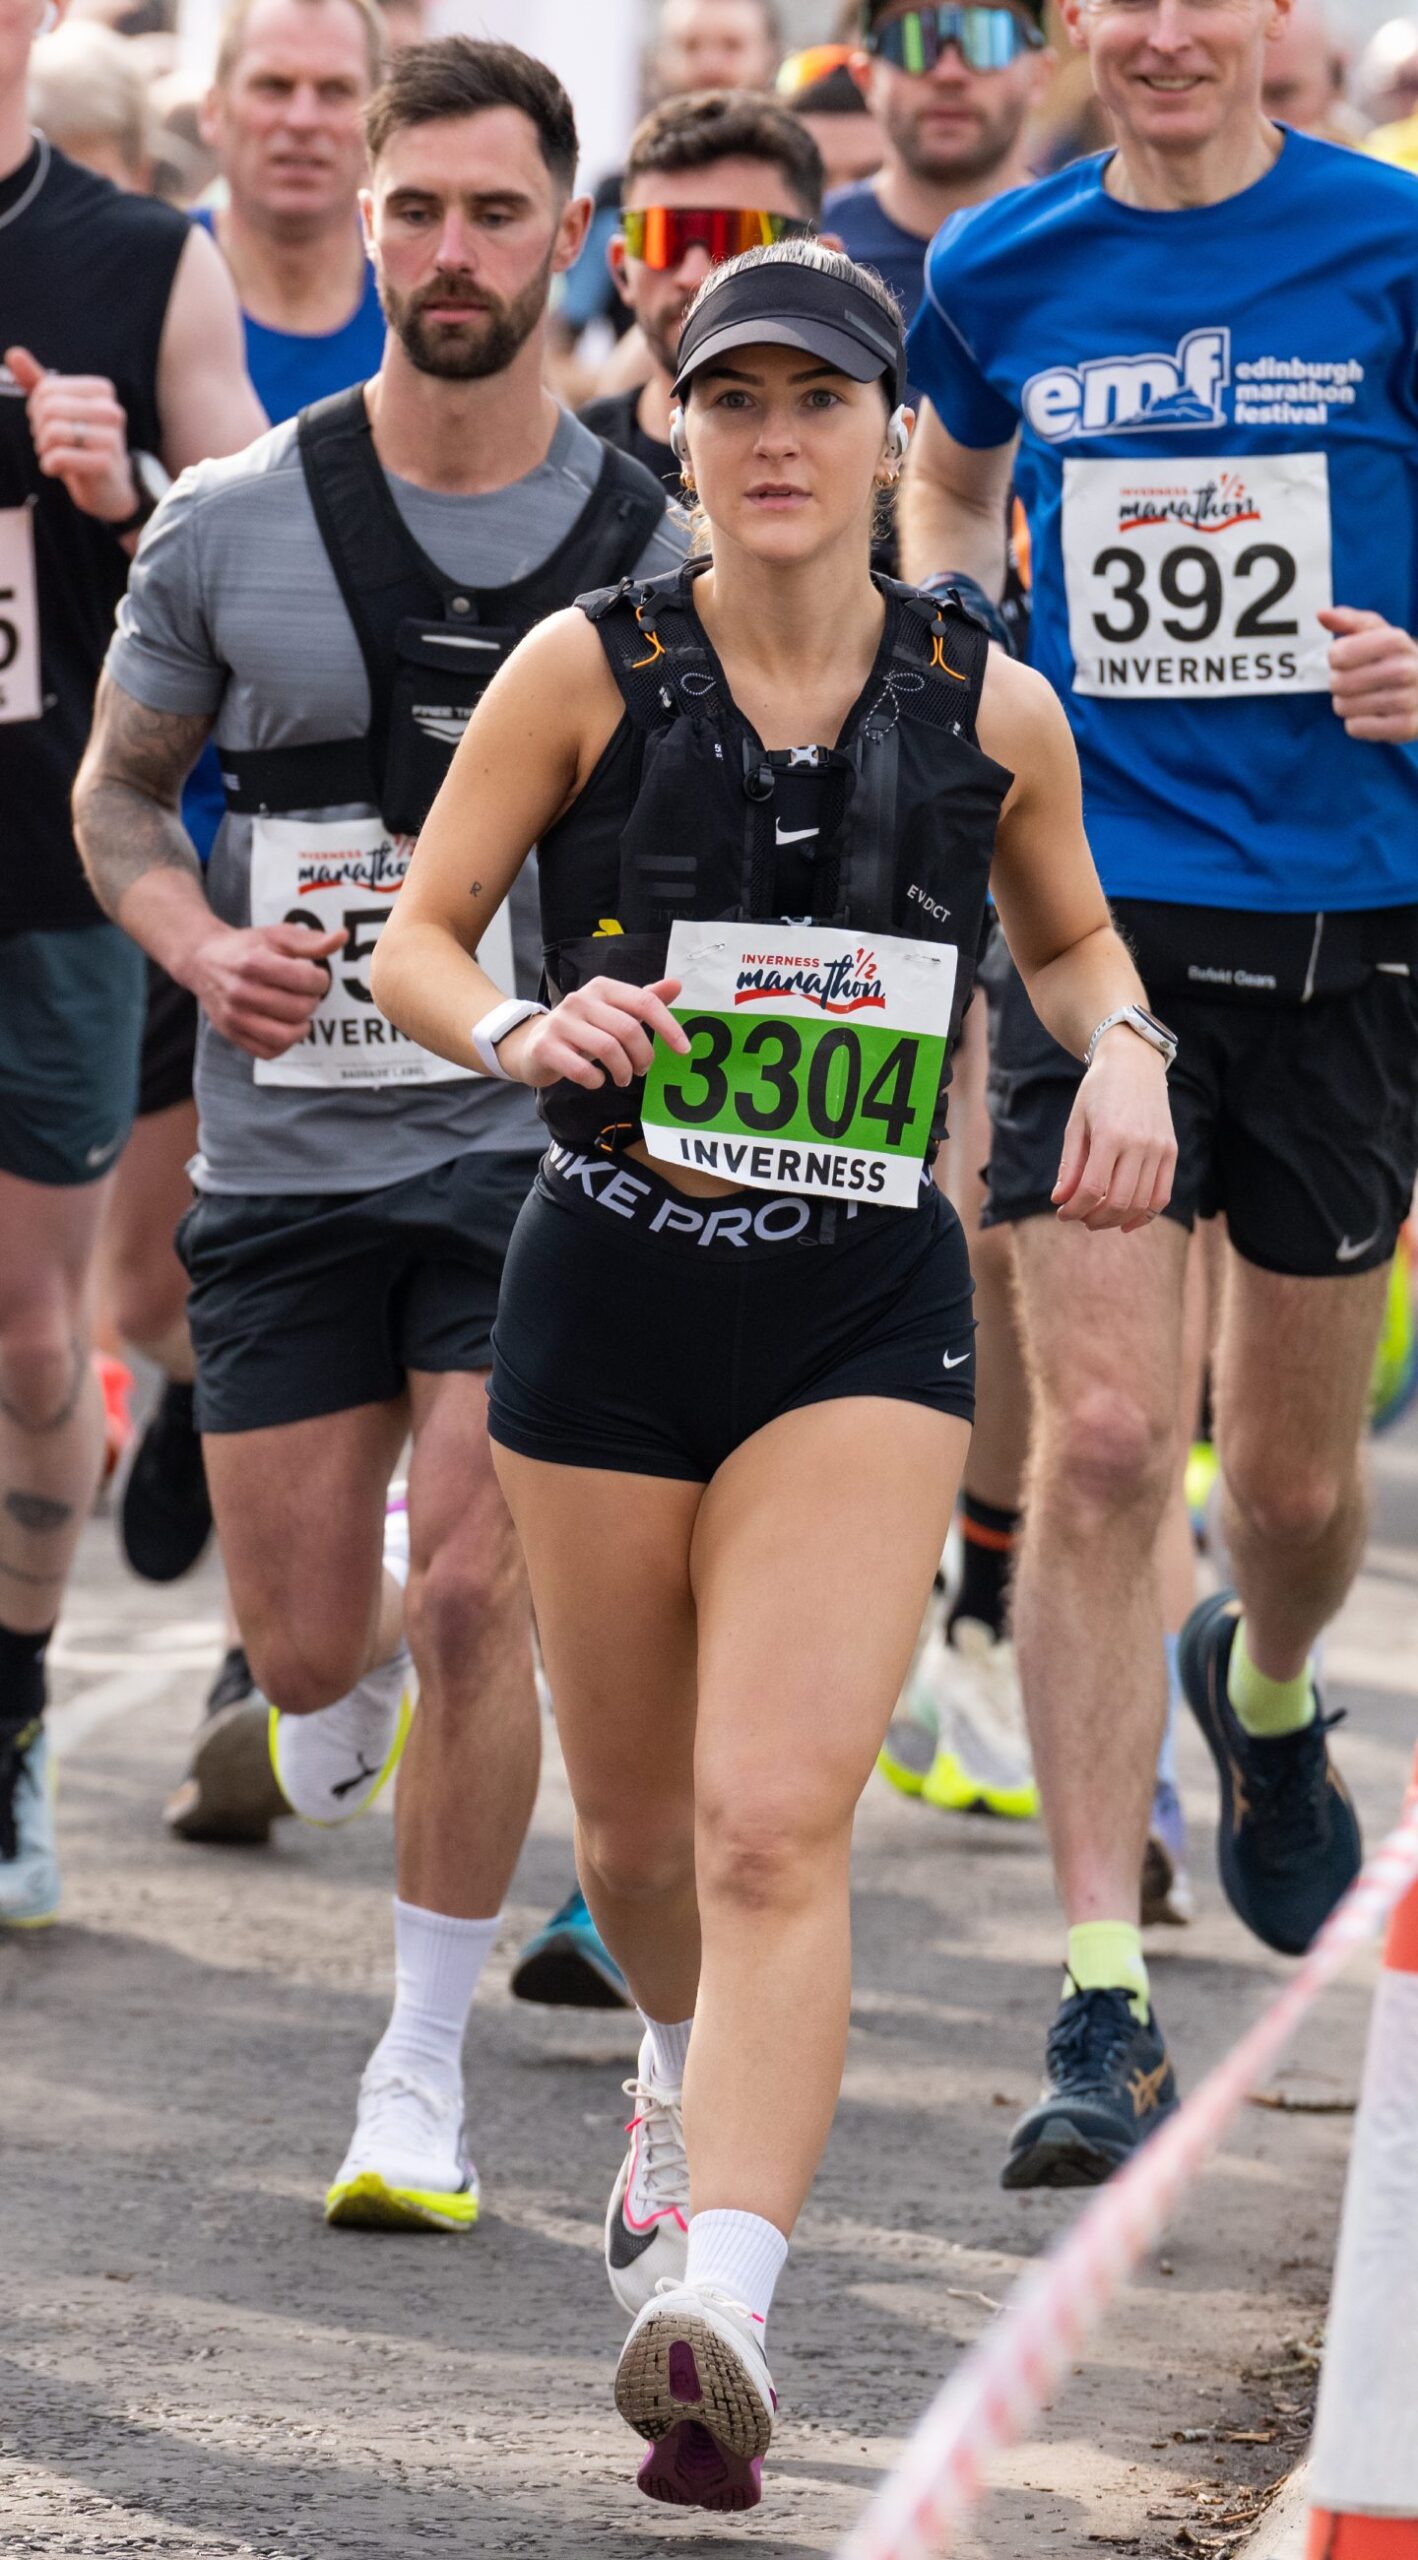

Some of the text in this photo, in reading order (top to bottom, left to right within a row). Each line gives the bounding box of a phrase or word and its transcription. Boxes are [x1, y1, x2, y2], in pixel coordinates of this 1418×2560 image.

[1022, 327, 1230, 444] emf
[1235, 356, 1364, 383] edinburgh
[1235, 381, 1355, 404] marathon
[1235, 403, 1327, 425] festival
[1119, 480, 1255, 530] marathon
[1091, 543, 1299, 644] 392
[1099, 653, 1297, 686] INVERNESS
[298, 840, 410, 892] maratho
[736, 954, 886, 1009] marathon
[741, 953, 820, 968] INVERNESS
[663, 1016, 920, 1147] 3304
[680, 1138, 887, 1193] INVERNESS
[649, 1197, 811, 1247] PRO
